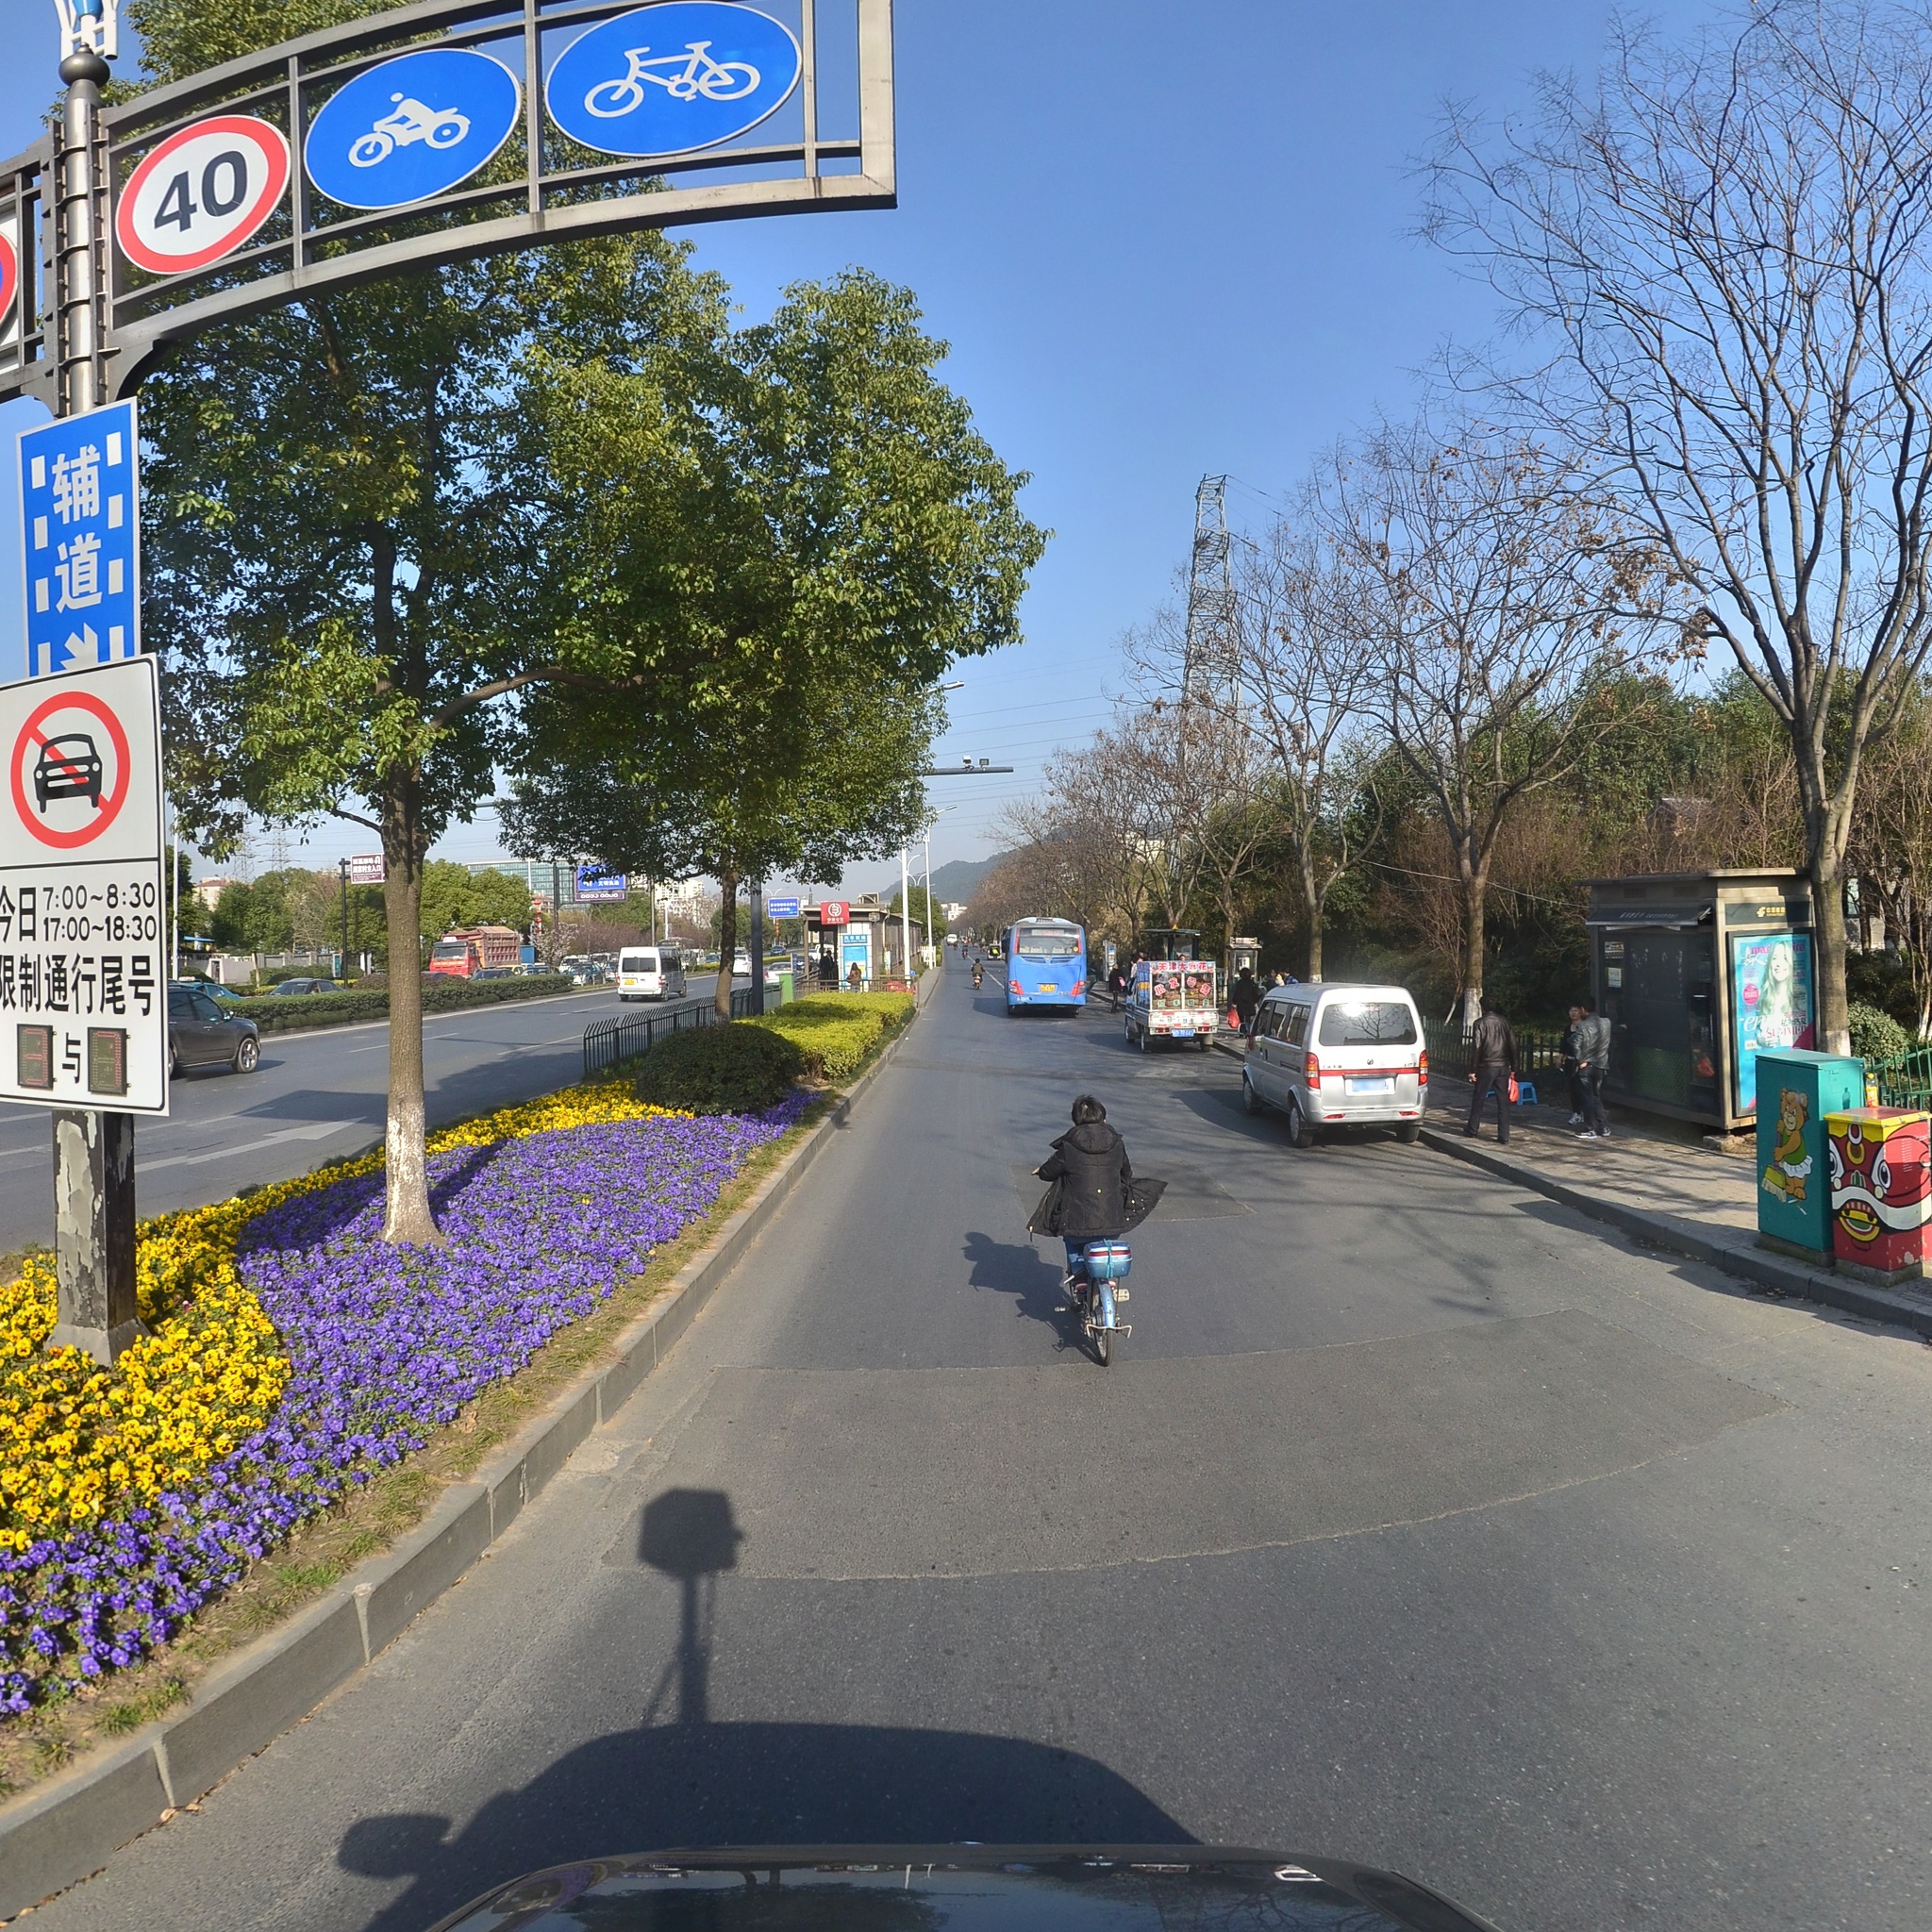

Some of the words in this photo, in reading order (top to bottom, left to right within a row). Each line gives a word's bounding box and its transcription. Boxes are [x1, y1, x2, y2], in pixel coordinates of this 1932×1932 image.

[154, 150, 247, 232] 40
[52, 443, 103, 613] 辅道
[0, 952, 155, 1016] 限制通行尾号
